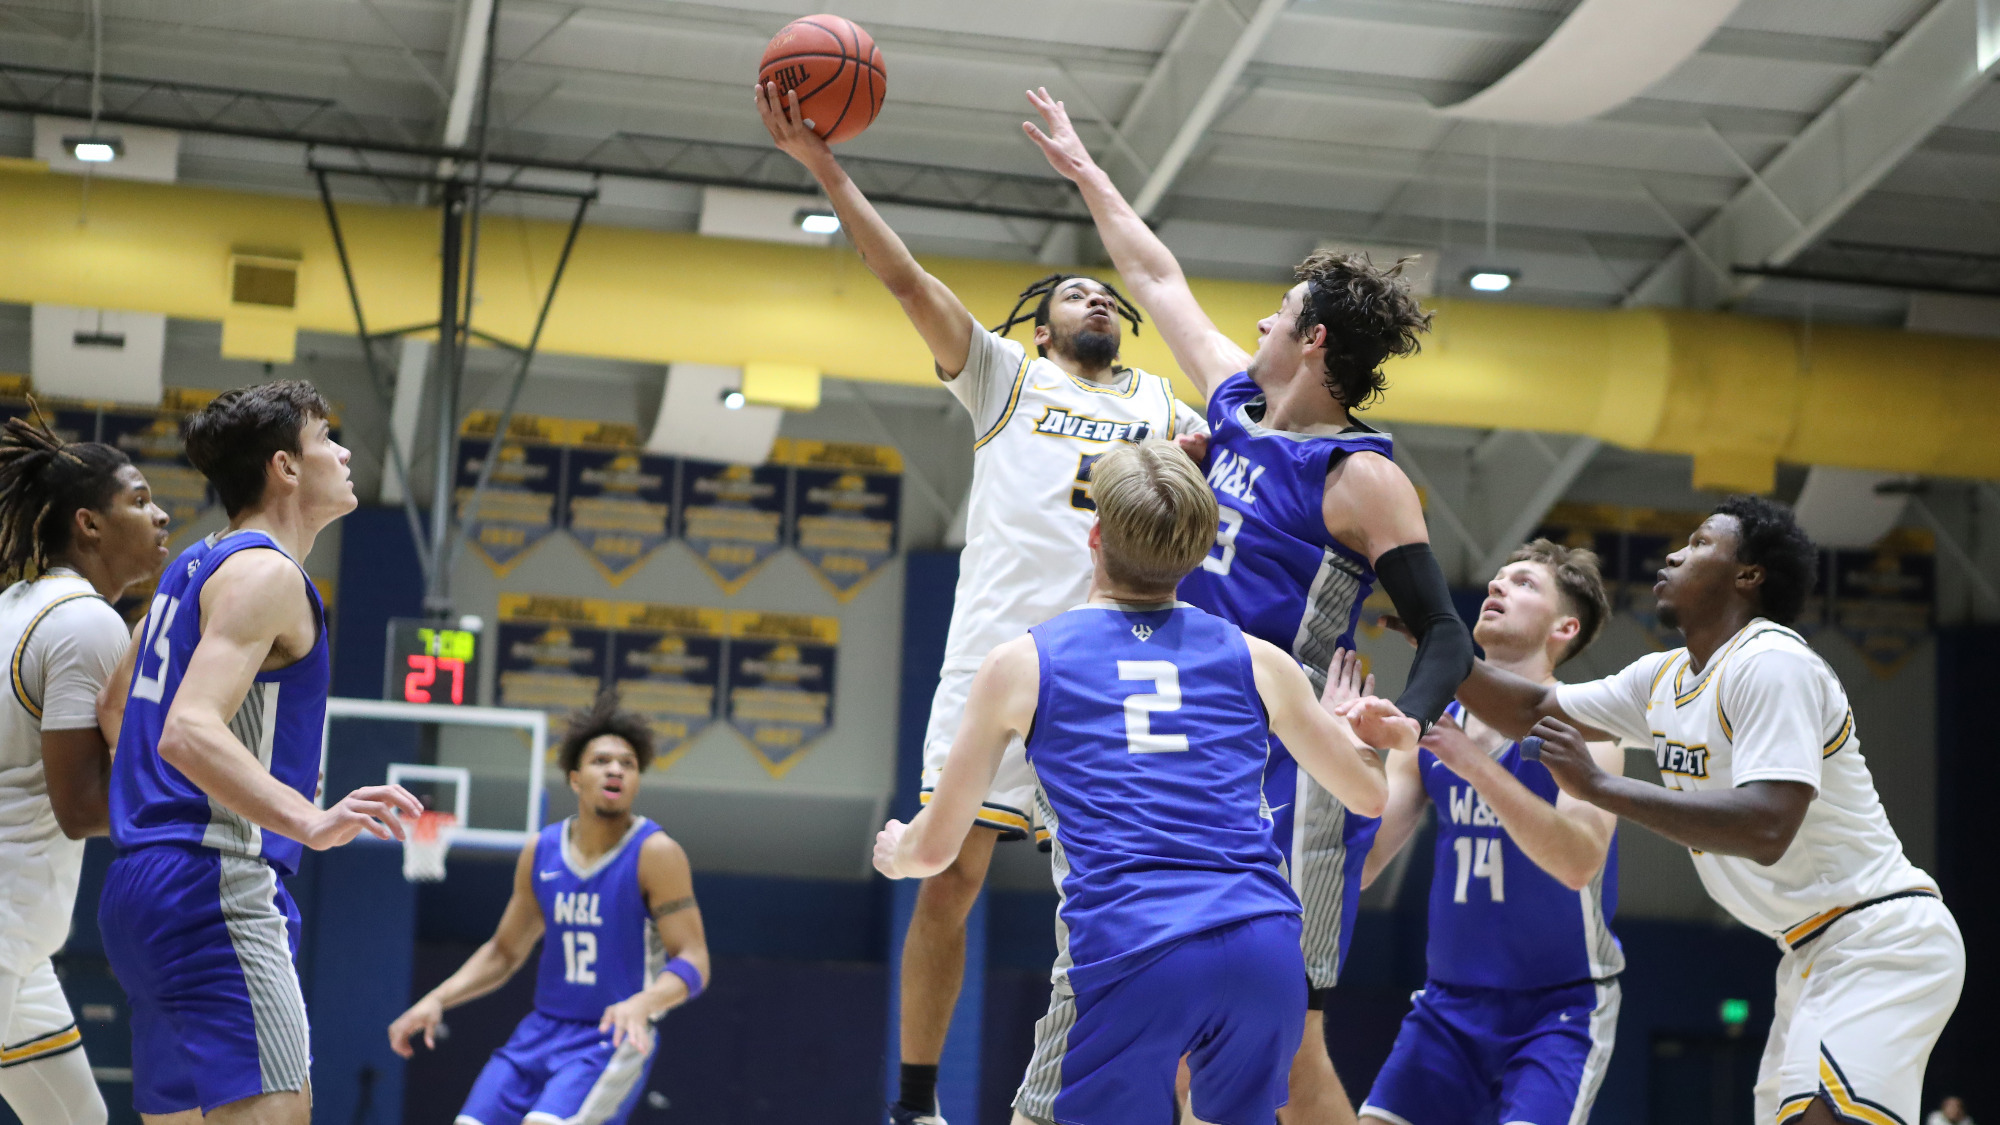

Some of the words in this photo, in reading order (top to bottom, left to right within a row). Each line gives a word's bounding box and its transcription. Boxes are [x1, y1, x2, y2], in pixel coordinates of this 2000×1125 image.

[775, 63, 811, 97] THE
[1206, 448, 1266, 504] W&L
[405, 654, 465, 705] 27
[1116, 660, 1190, 754] 2
[1449, 785, 1502, 827] W&
[1454, 836, 1505, 903] 14
[554, 892, 603, 926] W&L
[562, 931, 597, 985] 12
